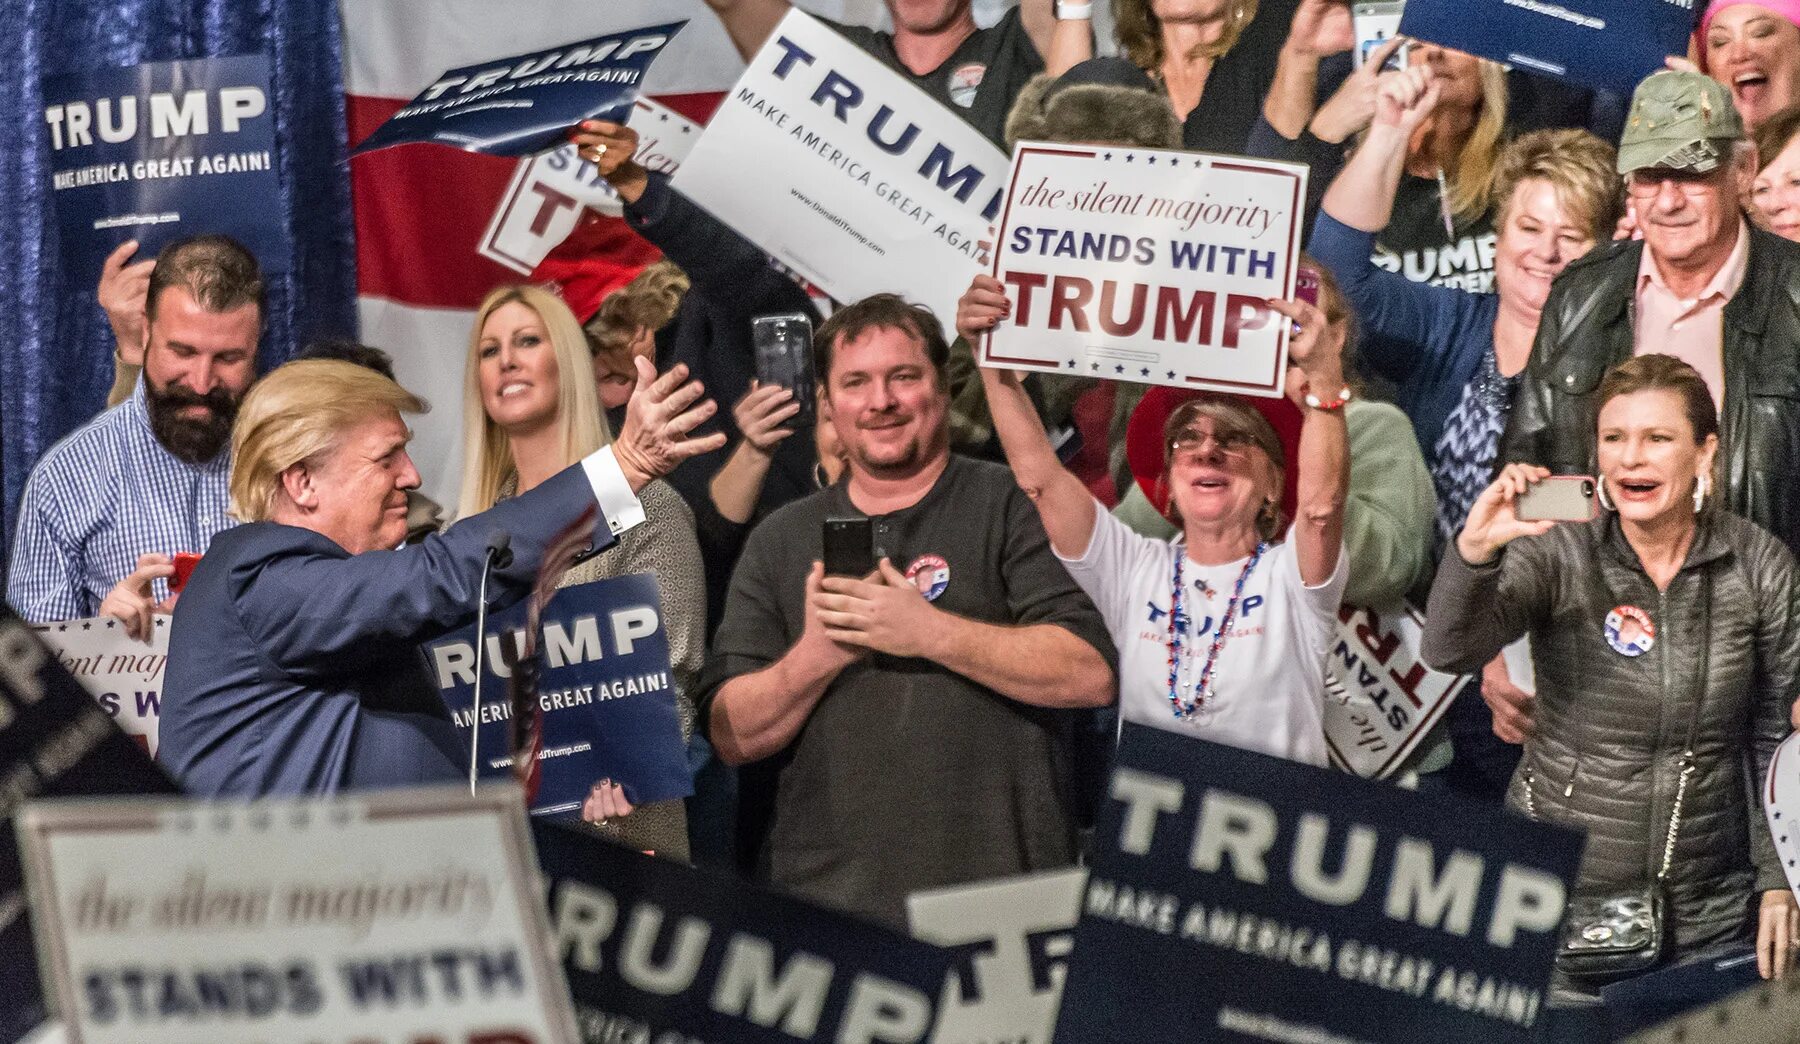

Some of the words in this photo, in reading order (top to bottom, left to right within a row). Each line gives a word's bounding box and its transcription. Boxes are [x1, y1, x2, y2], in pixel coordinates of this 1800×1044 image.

[425, 34, 669, 101] TRUMP
[518, 73, 574, 89] GREAT
[573, 69, 641, 85] AGAIN!
[46, 86, 266, 151] TRUMP
[76, 162, 129, 188] AMERICA
[133, 157, 194, 180] GREAT
[199, 151, 271, 176] AGAIN!
[737, 87, 791, 129] MAKE
[790, 124, 872, 185] AMERICA
[875, 182, 937, 227] GREAT
[933, 223, 988, 260] AGAI
[790, 187, 886, 256] www.DonaldJTrump.com
[1019, 177, 1066, 210] the
[1067, 181, 1144, 218] silent
[1146, 193, 1283, 240] majority
[1010, 225, 1157, 266] STANDS
[1171, 239, 1277, 280] WITH
[1005, 270, 1273, 350] TRUMP
[433, 606, 660, 690] RUMP
[539, 686, 594, 712] GREAT
[600, 672, 669, 702] AGAIN!
[1334, 639, 1409, 732] STAN
[1109, 766, 1569, 949] TRUMP
[83, 958, 326, 1028] STANDS
[341, 945, 526, 1006] WITH
[554, 877, 934, 1044] RUMP
[1088, 880, 1179, 936] MAKE
[1179, 905, 1333, 974] AMERICA
[1335, 937, 1436, 999] GREAT
[1433, 965, 1542, 1029] AGAIN!
